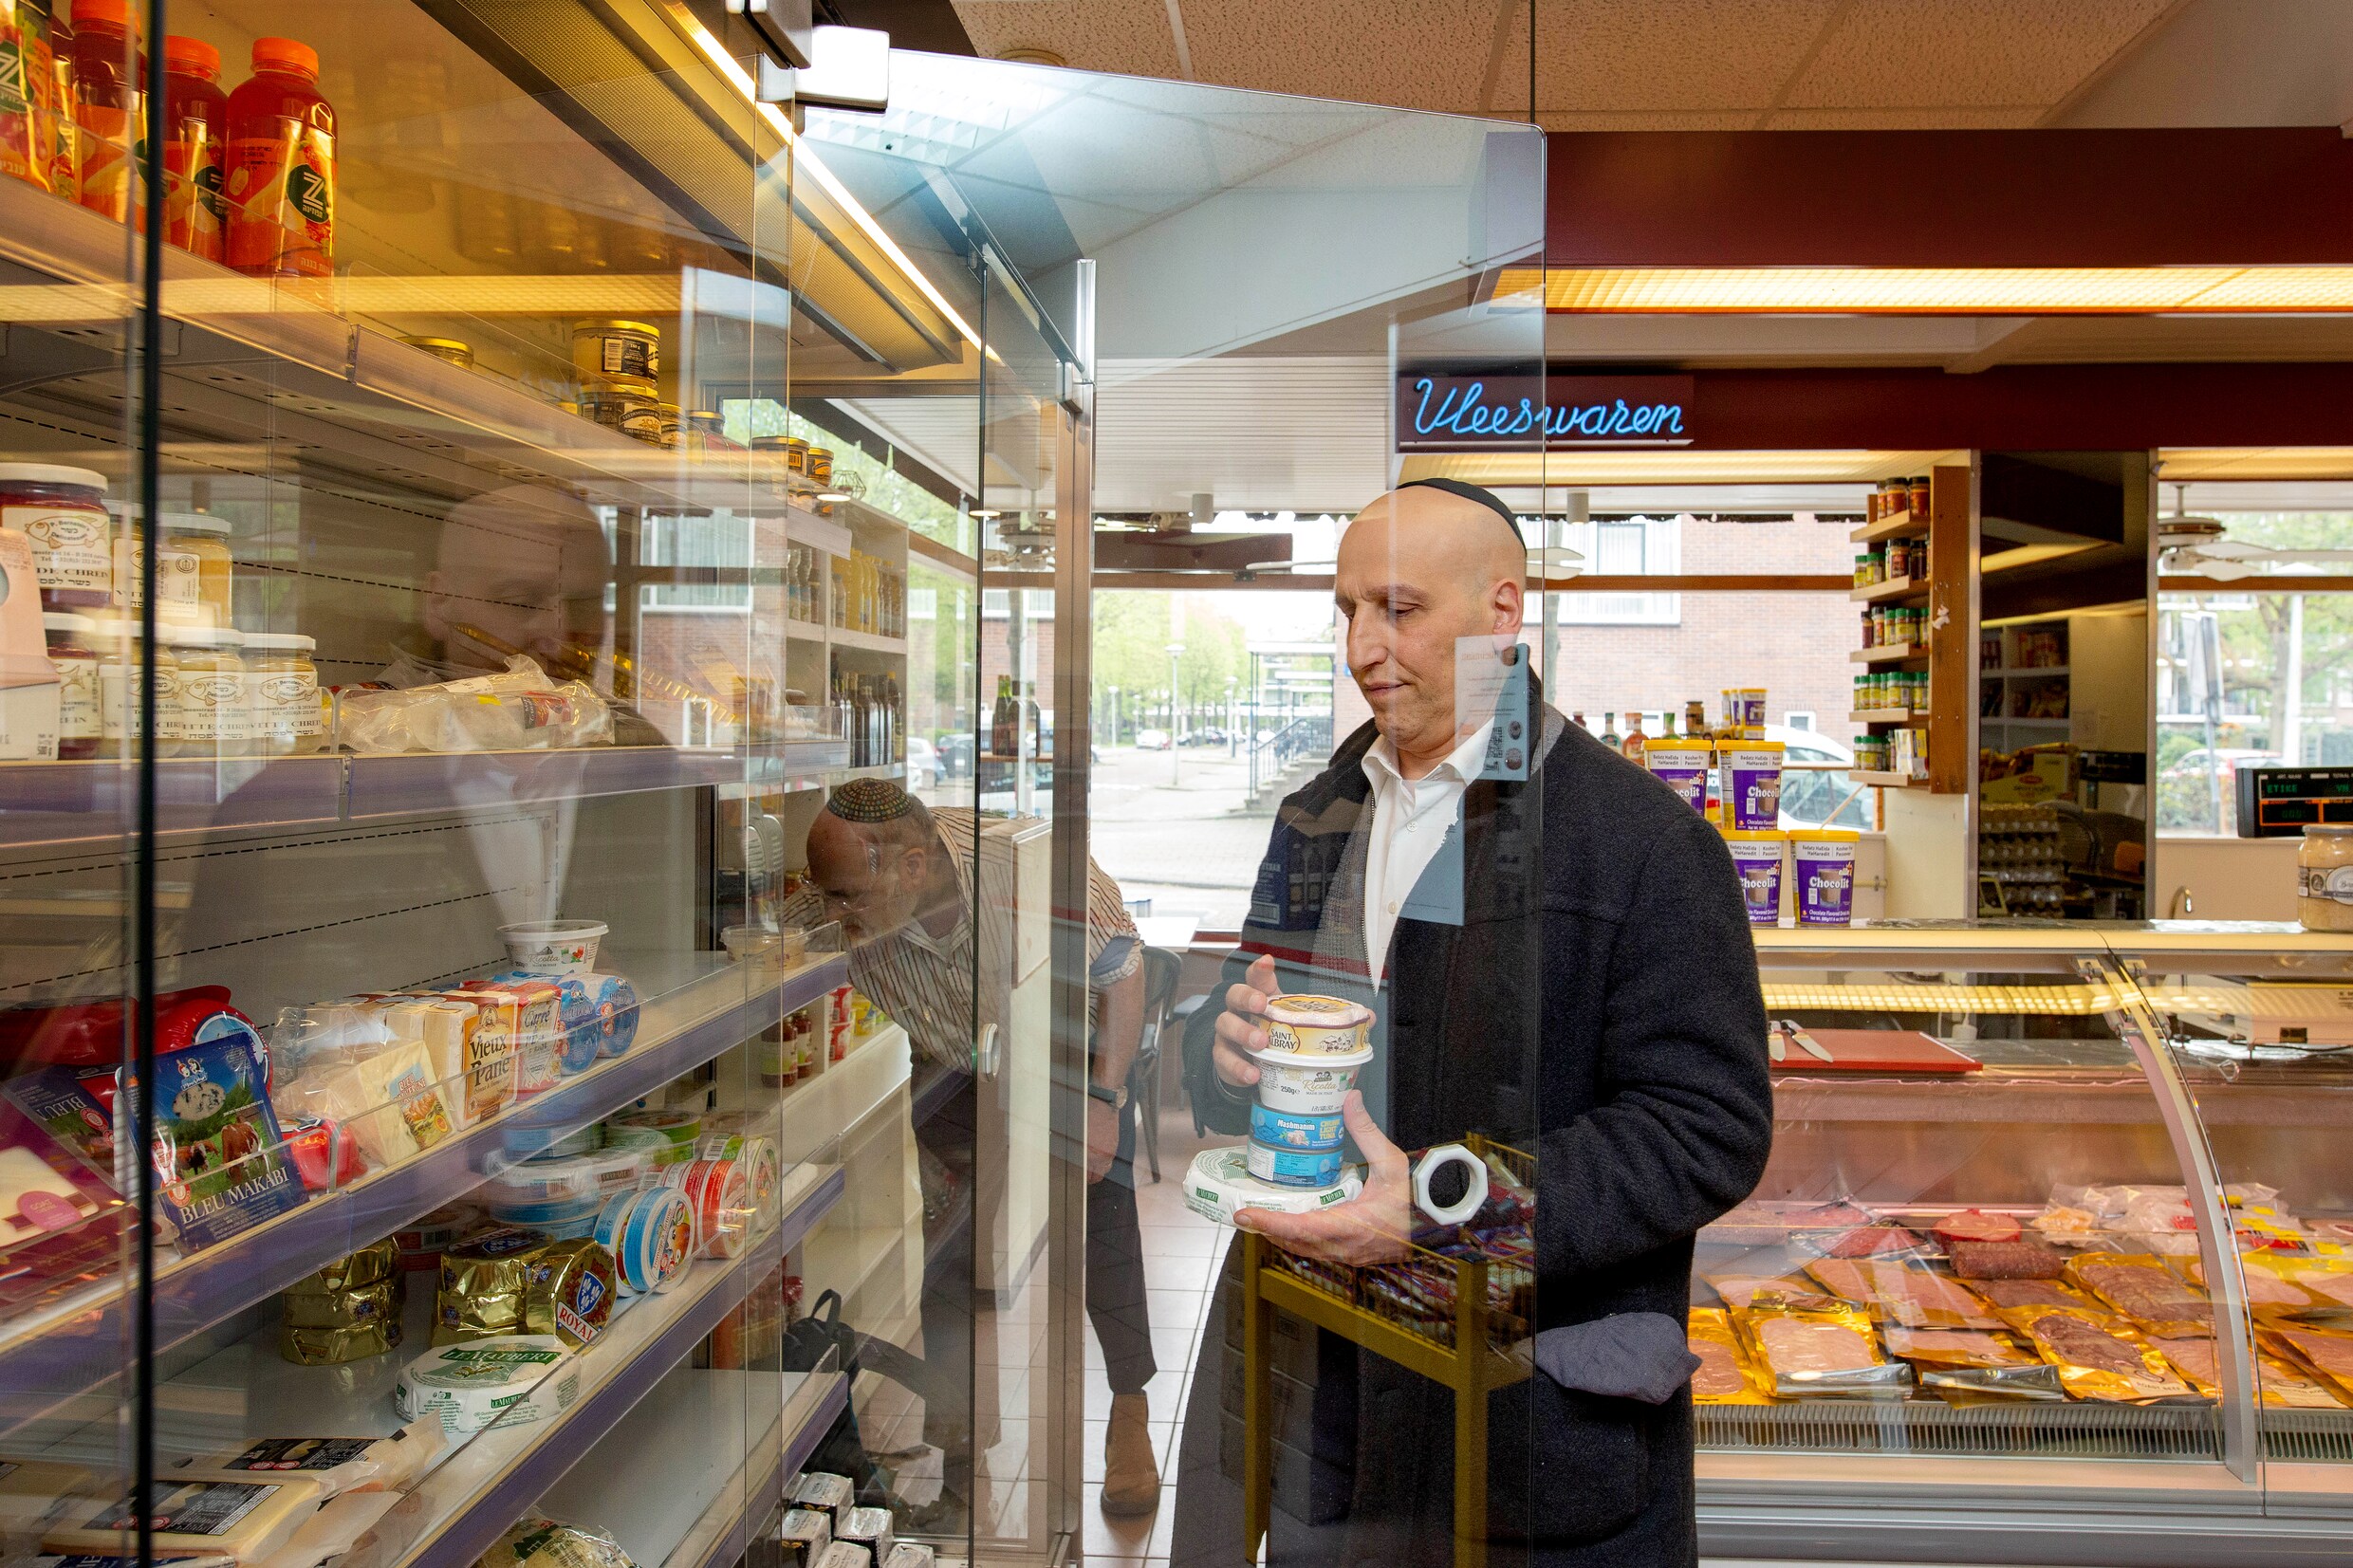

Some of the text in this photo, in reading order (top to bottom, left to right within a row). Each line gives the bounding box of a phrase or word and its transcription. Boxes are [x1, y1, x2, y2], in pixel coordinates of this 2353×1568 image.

[1415, 378, 1684, 436] Vleeswaren
[1809, 876, 1849, 889] Chocolit
[1270, 1028, 1292, 1041] SAINT
[470, 1033, 508, 1060] Vieux
[471, 1051, 510, 1087] Pané
[1303, 1079, 1337, 1091] Ricotta
[1277, 1119, 1315, 1131] Mashmanim
[179, 1192, 227, 1225] BLEU
[227, 1166, 290, 1206] MAKABI
